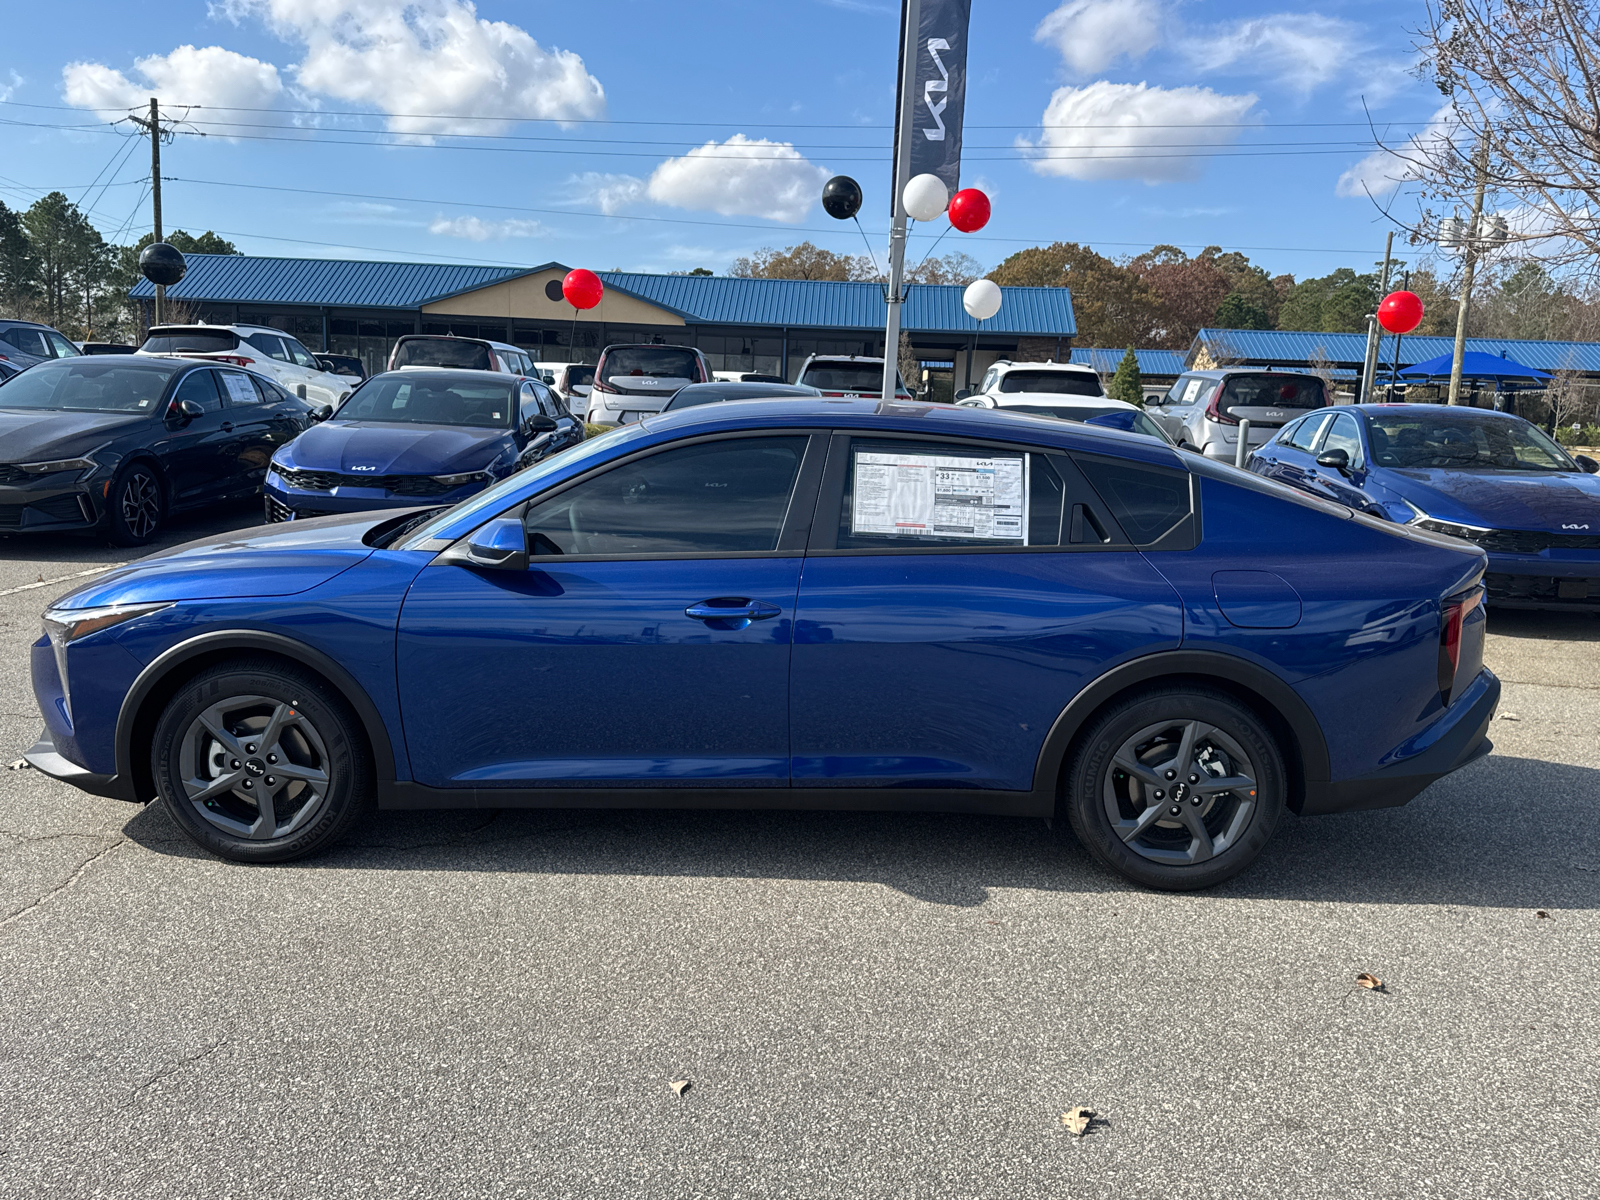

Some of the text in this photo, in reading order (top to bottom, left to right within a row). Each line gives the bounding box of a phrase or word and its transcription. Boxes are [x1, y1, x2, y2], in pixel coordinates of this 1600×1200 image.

[923, 38, 950, 141] KIA
[940, 472, 950, 480] 33
[246, 761, 264, 775] KIA
[1084, 740, 1110, 798] KUMHO
[1174, 782, 1185, 802] KIA
[288, 809, 337, 852] KUMHO
